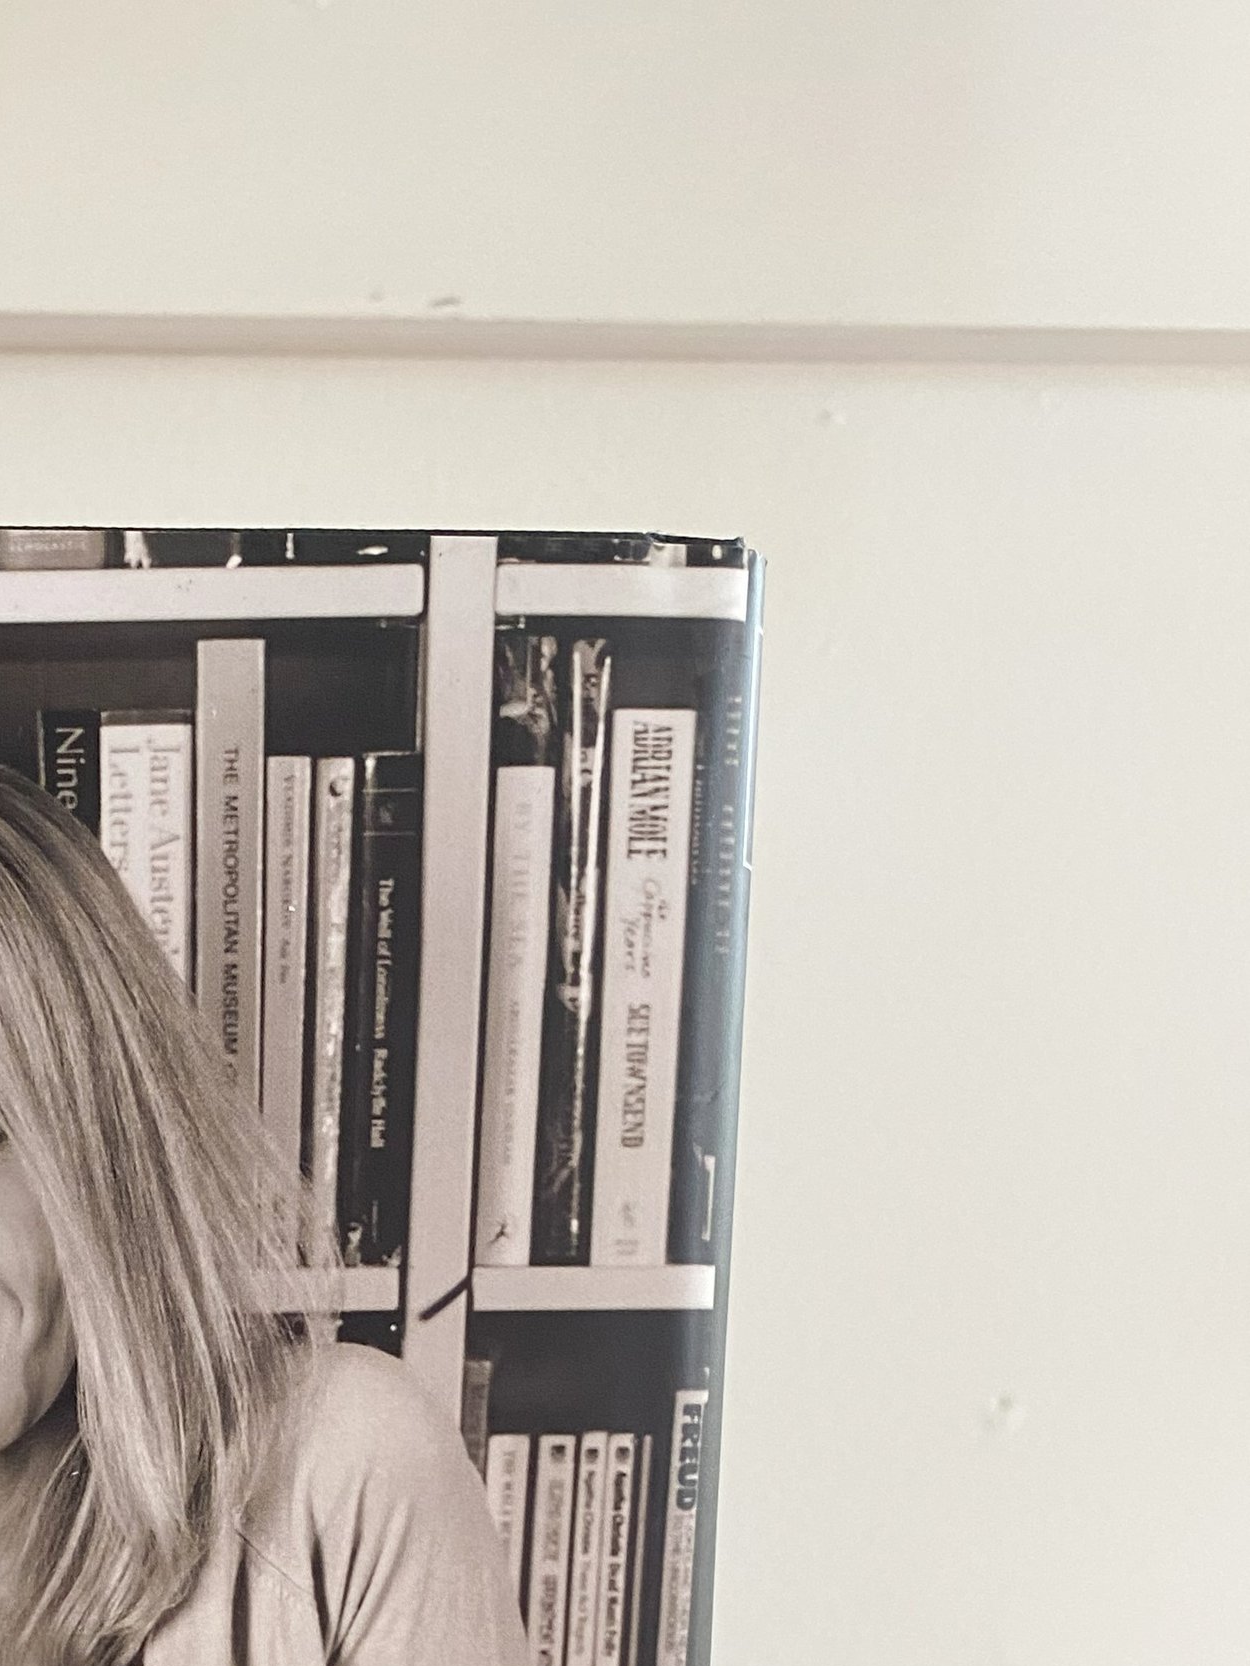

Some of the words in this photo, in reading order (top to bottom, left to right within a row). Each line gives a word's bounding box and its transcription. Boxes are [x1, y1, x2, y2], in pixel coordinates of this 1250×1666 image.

[55, 726, 86, 811] Nine
[222, 748, 239, 786] THE
[629, 719, 674, 800] ADRIAN
[626, 803, 671, 860] MOLE
[222, 795, 240, 955] METROPOLITAN
[222, 963, 239, 1056] MUSEUM
[677, 1403, 702, 1511] FREUD
